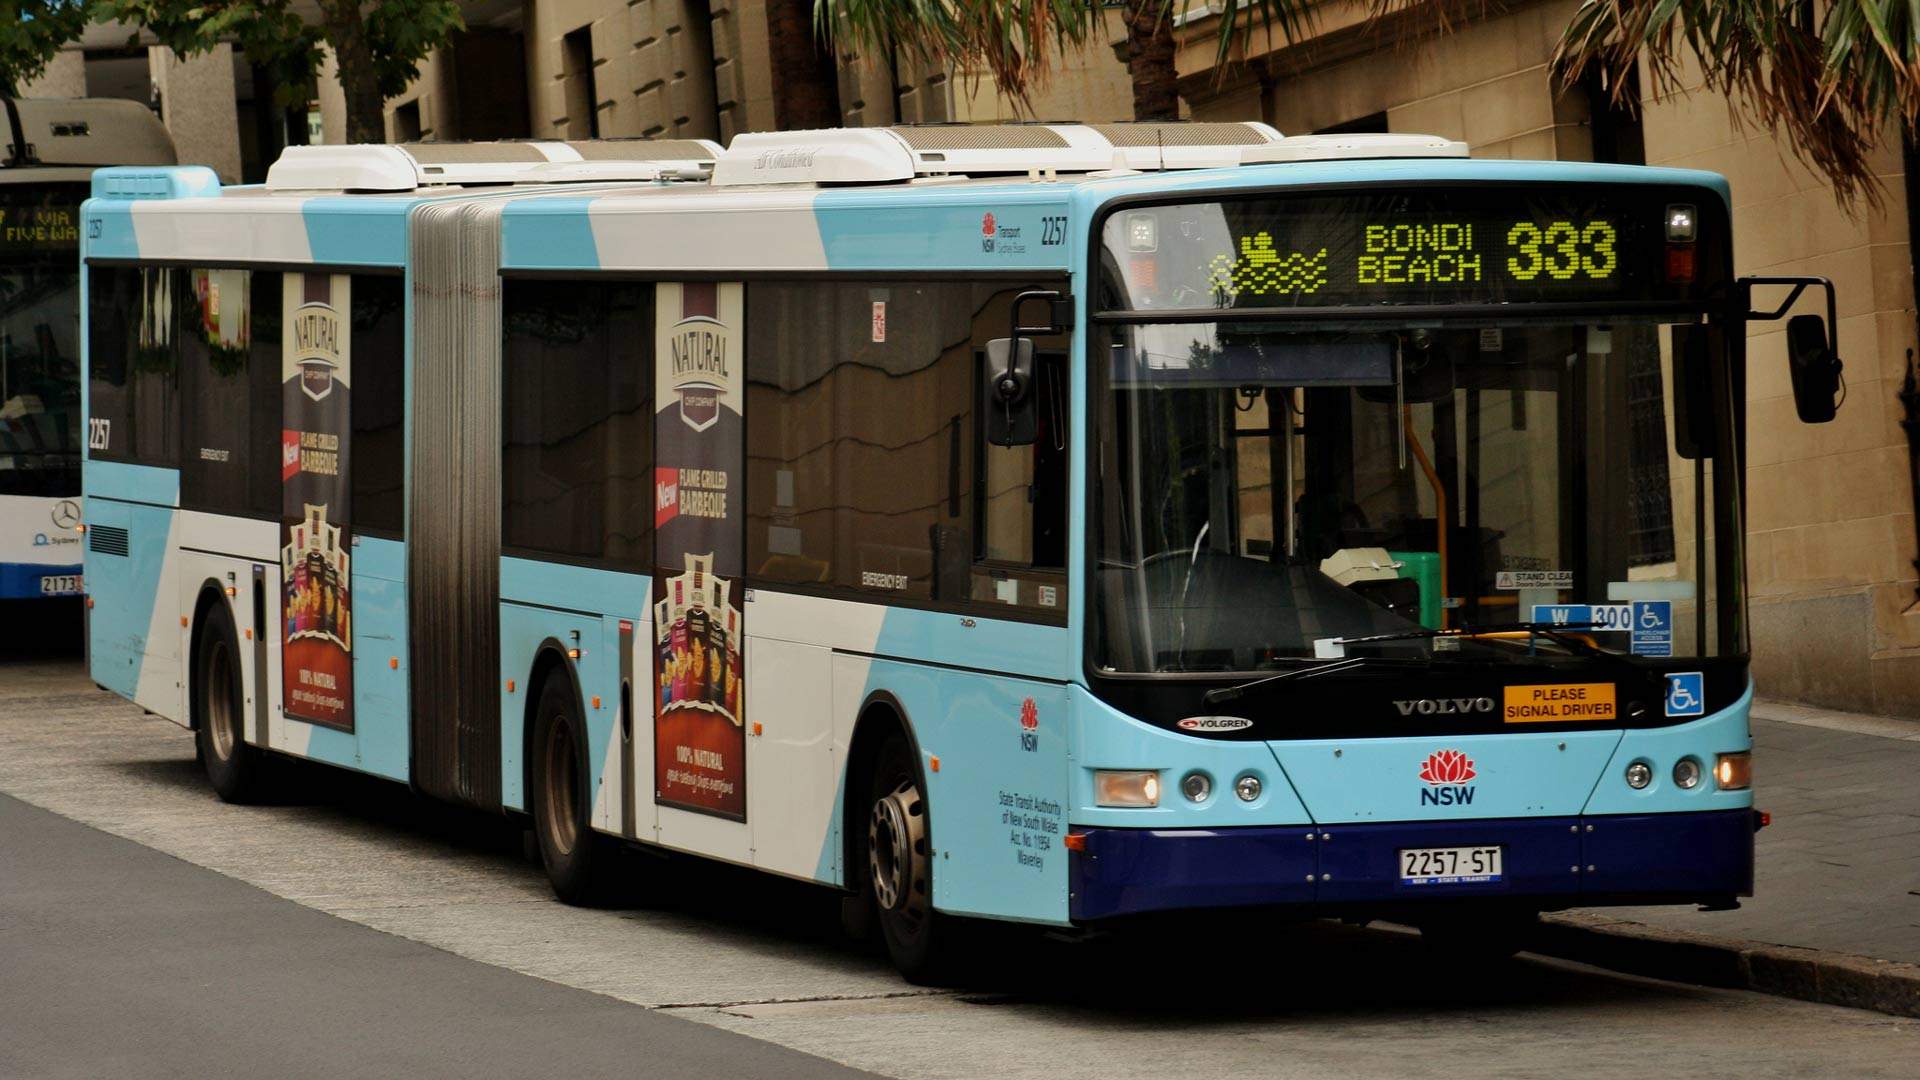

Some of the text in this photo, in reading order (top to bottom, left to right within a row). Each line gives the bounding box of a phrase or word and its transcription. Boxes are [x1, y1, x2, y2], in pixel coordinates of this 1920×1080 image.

[36, 211, 69, 225] VIA
[6, 227, 46, 240] FIVE
[1041, 216, 1068, 245] 2257
[1366, 224, 1472, 252] BONDI
[983, 239, 995, 253] NSW
[1507, 221, 1616, 280] 333
[1358, 254, 1481, 283] BEACH
[294, 314, 339, 355] NATURAL
[672, 331, 729, 377] NATURAL
[89, 418, 111, 450] 2257
[680, 468, 727, 490] FLAME GRILLED
[657, 481, 677, 511] New
[680, 490, 727, 518] BARBEQUE
[44, 577, 76, 592] 2173
[862, 571, 908, 589] EMERGENCY EXIT
[1515, 572, 1571, 581] STAND CLEA
[1551, 608, 1570, 626] W
[1533, 688, 1587, 701] PLEASE
[1393, 697, 1495, 716] VOLVO
[1507, 703, 1613, 718] SIGNAL DRIVER
[1200, 719, 1248, 728] VOLGREN
[1021, 733, 1039, 752] NSW
[676, 745, 724, 770] 100% NATURAL
[999, 790, 1061, 819] State Transit Authority
[1421, 786, 1476, 806] NSW
[1002, 809, 1058, 834] of New South Wales
[1018, 849, 1044, 873] Waverley
